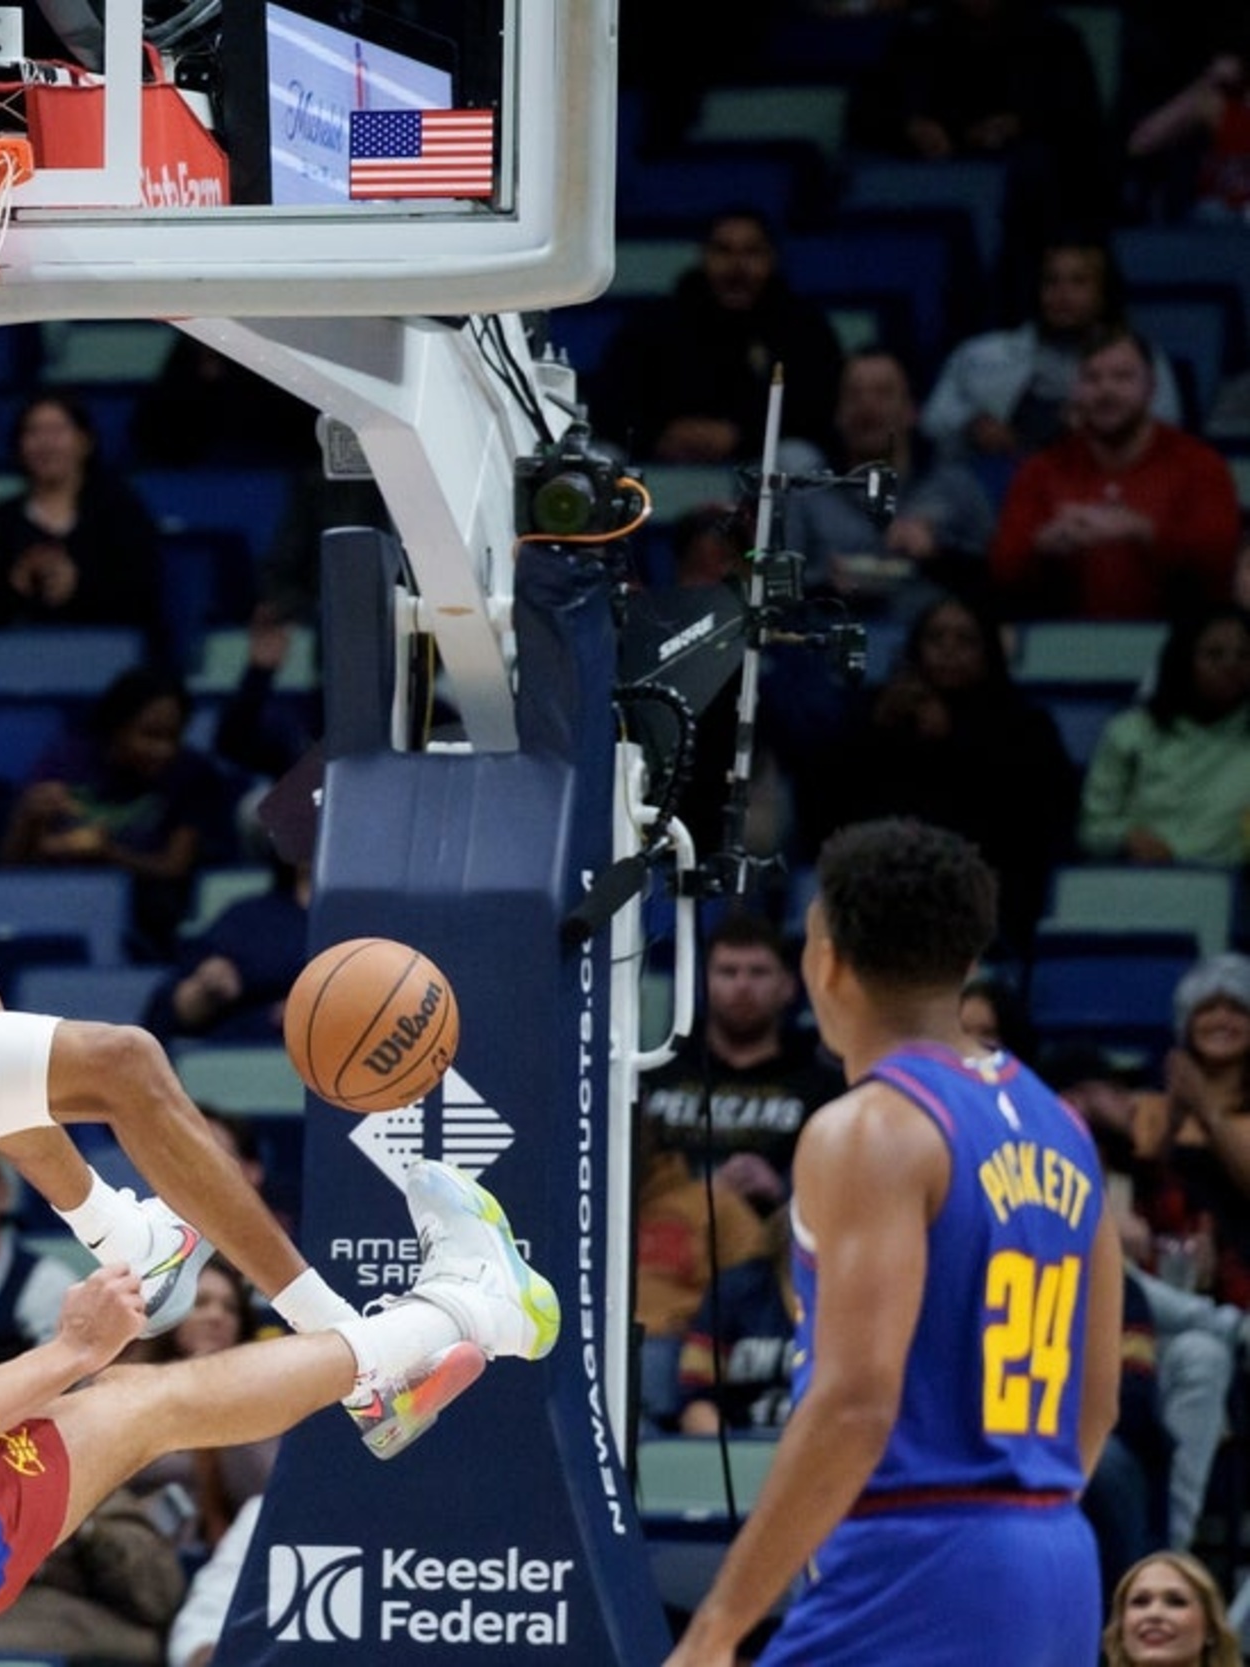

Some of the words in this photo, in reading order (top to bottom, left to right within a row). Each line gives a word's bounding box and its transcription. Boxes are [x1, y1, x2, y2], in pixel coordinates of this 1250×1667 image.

[363, 981, 442, 1075] Wilson
[979, 1140, 1091, 1229] PICKETT
[982, 1249, 1081, 1437] 24
[381, 1546, 574, 1592] Keesler
[380, 1598, 568, 1645] Federal
